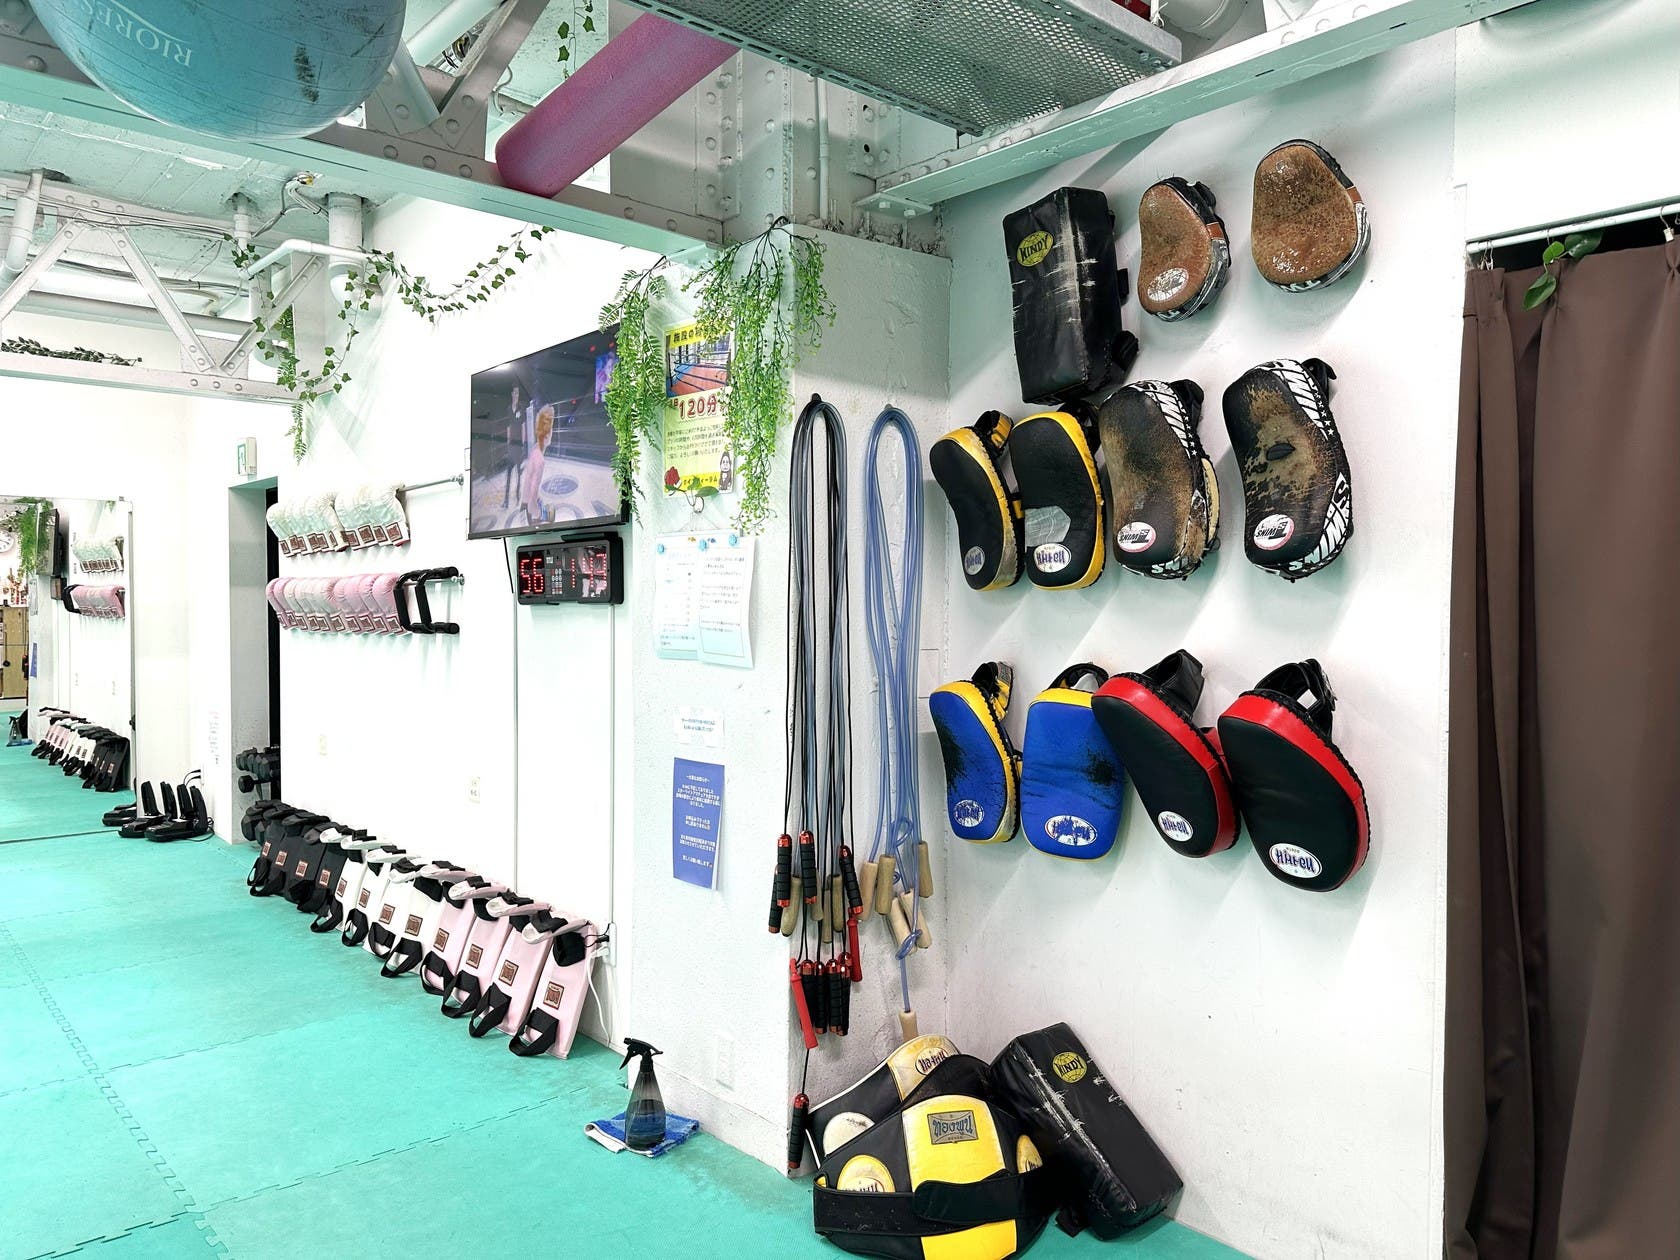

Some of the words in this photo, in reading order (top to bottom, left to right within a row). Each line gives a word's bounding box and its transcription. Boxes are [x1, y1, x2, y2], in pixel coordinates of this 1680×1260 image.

[1019, 233, 1050, 262] WINDY
[520, 558, 544, 593] 56
[1054, 1056, 1084, 1077] WINDY
